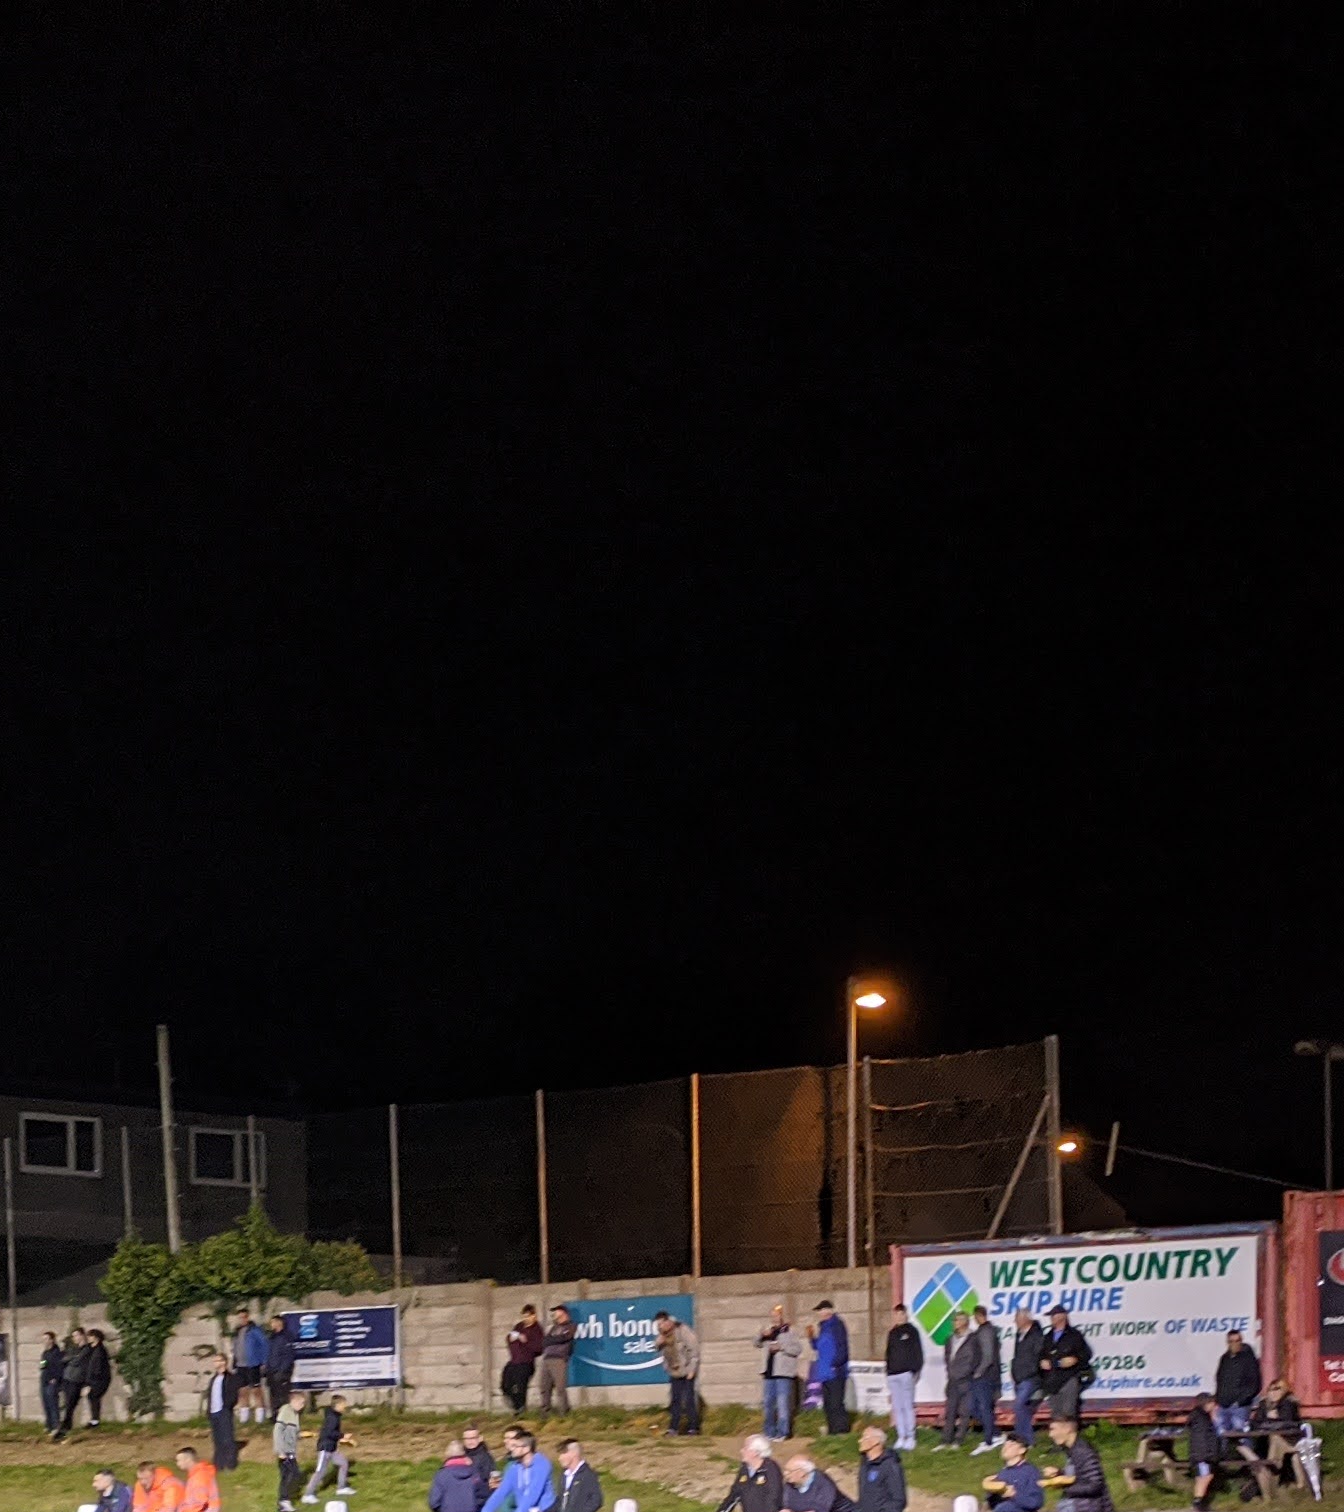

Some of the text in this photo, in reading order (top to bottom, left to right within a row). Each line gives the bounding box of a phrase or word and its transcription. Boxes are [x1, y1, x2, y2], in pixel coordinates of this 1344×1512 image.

[989, 1246, 1240, 1288] WESTCOUNTRY
[989, 1286, 1125, 1316] SKIP HIRE
[1109, 1320, 1158, 1336] WORK
[1164, 1319, 1188, 1334] OF
[1191, 1316, 1251, 1333] WASTE
[1090, 1353, 1147, 1371] 49286
